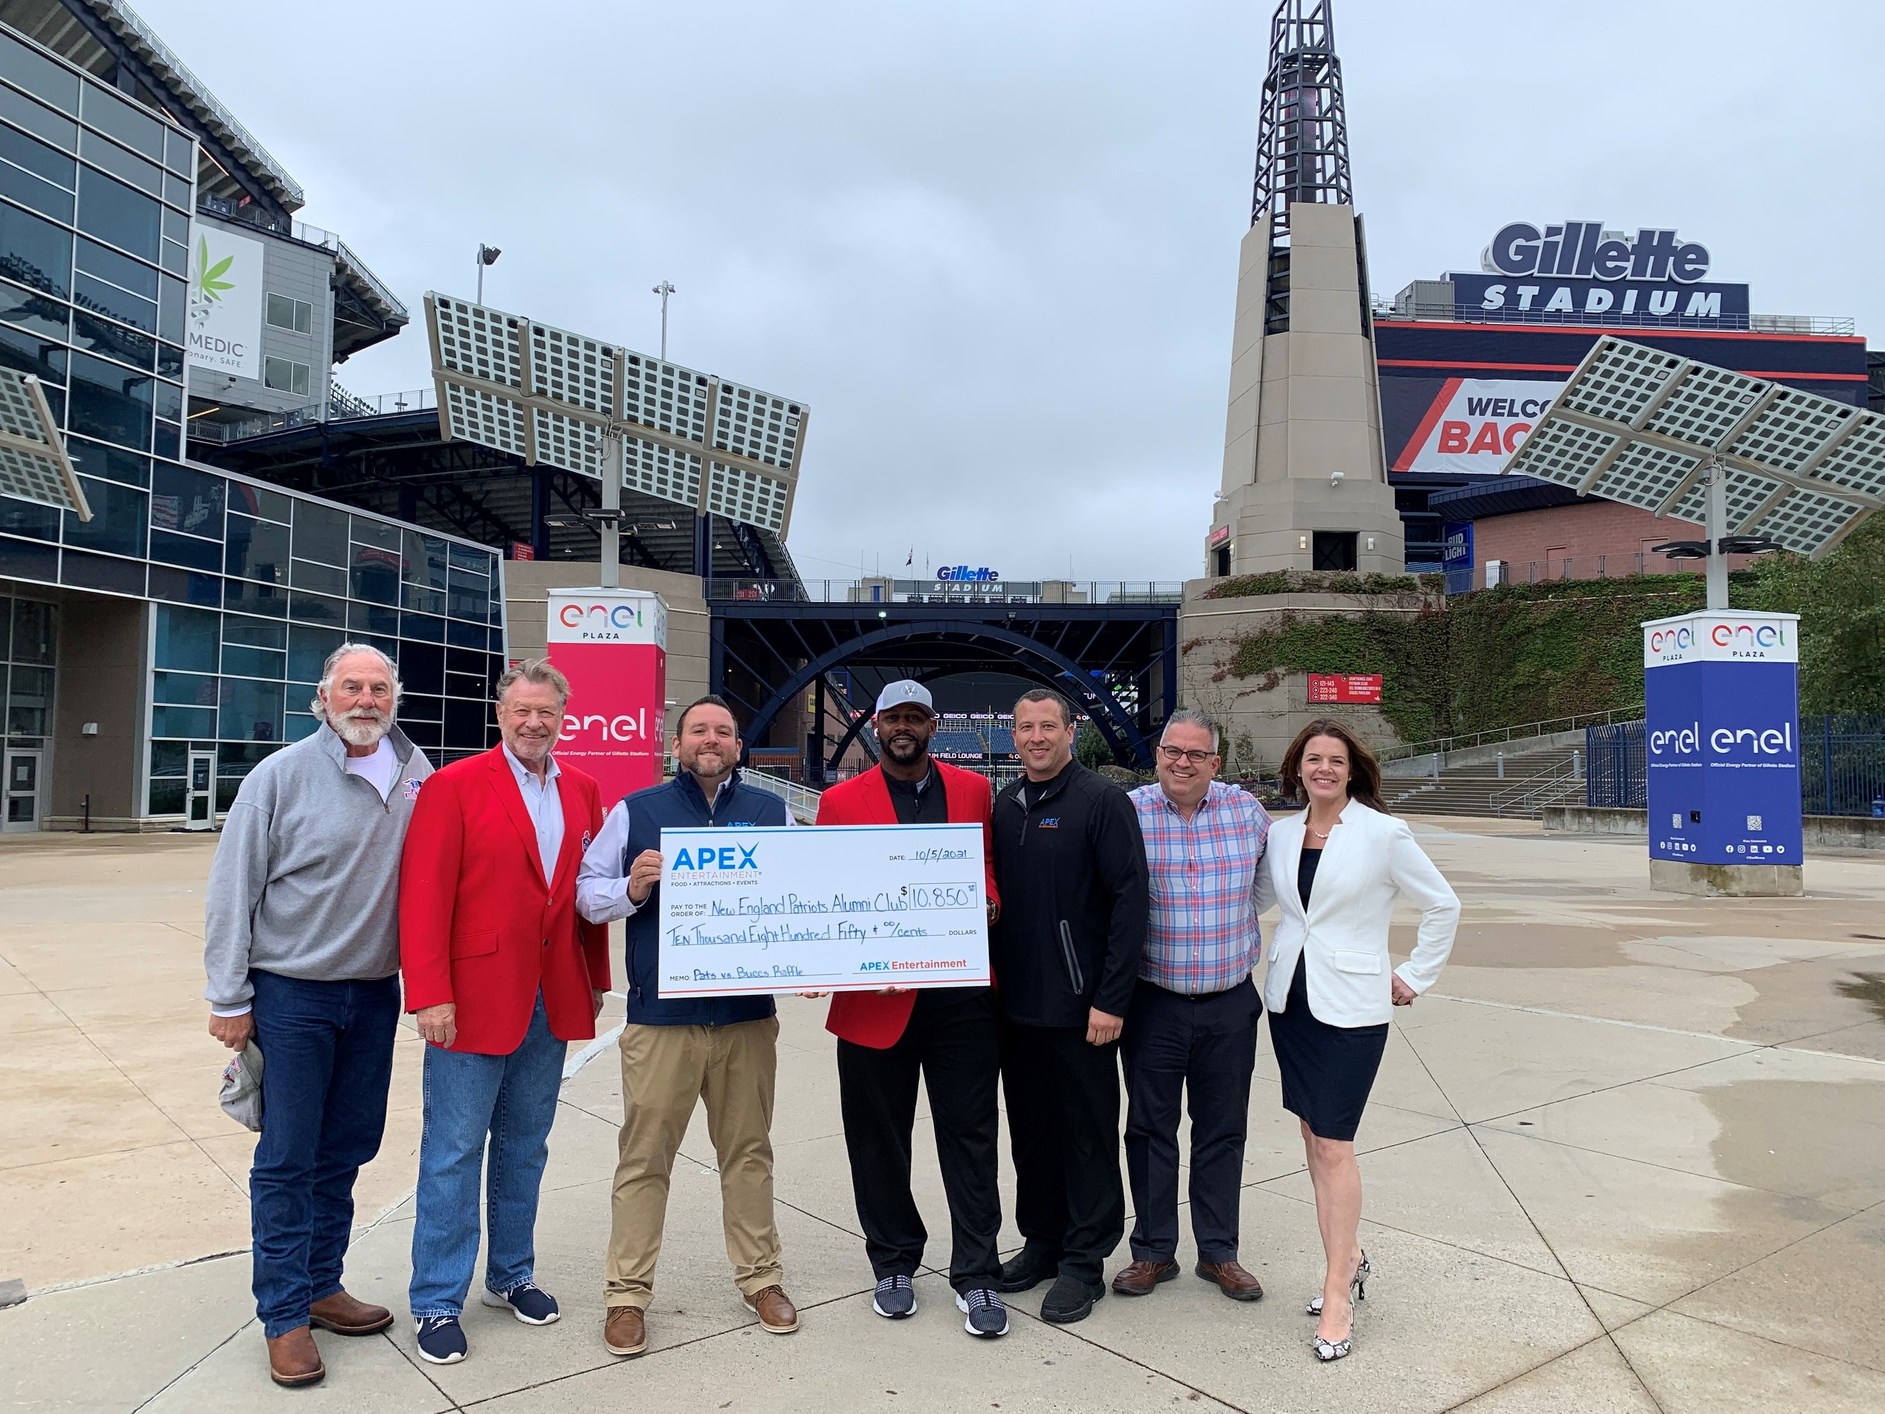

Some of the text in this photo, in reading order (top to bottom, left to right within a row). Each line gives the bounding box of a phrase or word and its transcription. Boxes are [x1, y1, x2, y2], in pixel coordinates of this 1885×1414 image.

[1490, 220, 1711, 284] Gillette
[1481, 285, 1721, 317] STADIUM
[190, 332, 244, 357] MEDIC
[936, 565, 999, 582] Gillette
[560, 600, 643, 629] enel
[583, 632, 620, 640] PLAZA
[1651, 620, 1696, 653] enel
[1712, 620, 1785, 648] enel
[1663, 654, 1683, 662] PLAZA
[559, 708, 647, 741] enel
[1651, 721, 1700, 754] enel
[1710, 722, 1793, 754] enel
[1040, 817, 1060, 826] APEX
[672, 841, 760, 870] APEX
[915, 848, 967, 865] 10/5/2021
[900, 886, 908, 896] $
[712, 893, 908, 923] New England Patriots Alumni Club
[691, 923, 746, 944] Thousand
[749, 925, 779, 950] Eight
[780, 924, 830, 942] Hundred
[838, 921, 866, 945] Fifty
[860, 960, 967, 971] APEX Entertainment
